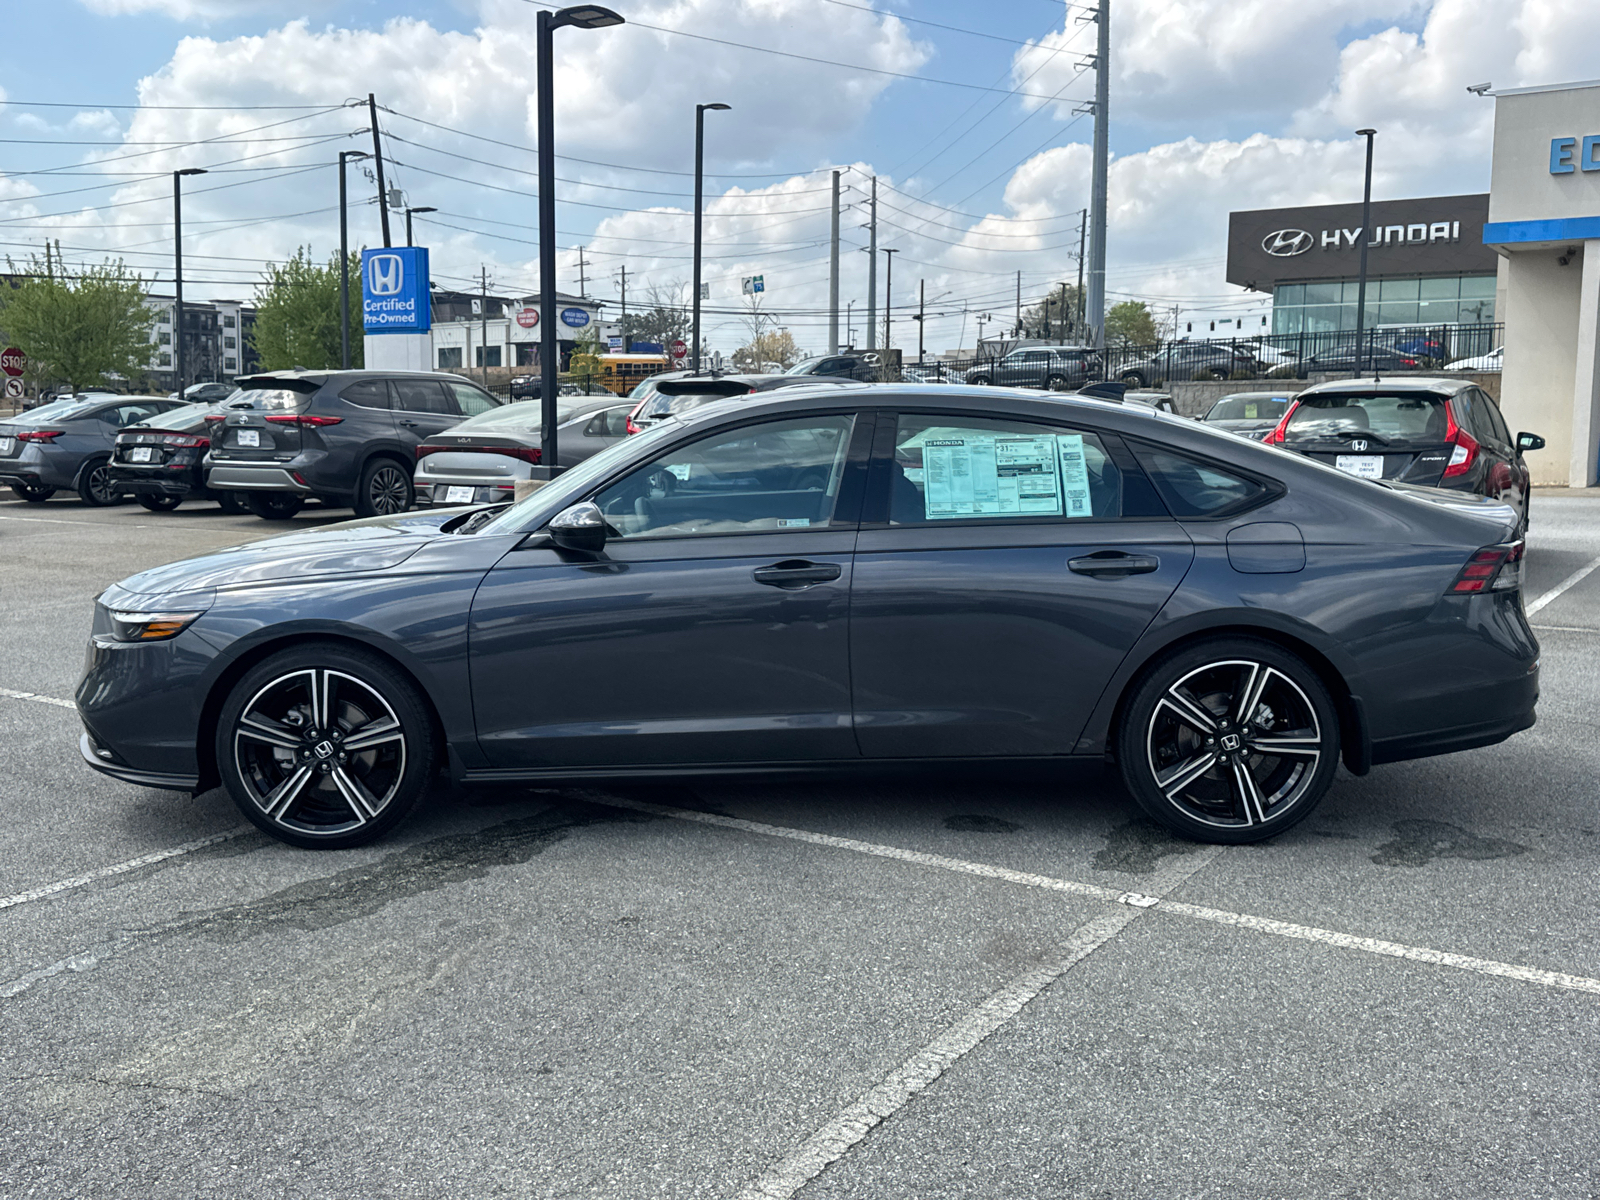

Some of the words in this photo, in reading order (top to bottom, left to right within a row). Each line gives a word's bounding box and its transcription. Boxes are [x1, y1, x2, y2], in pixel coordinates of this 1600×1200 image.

[1321, 221, 1460, 250] HYUNDAI
[363, 297, 415, 312] Certified
[363, 312, 416, 324] Pre-Owned
[672, 345, 686, 354] STOP
[2, 355, 27, 368] STOP
